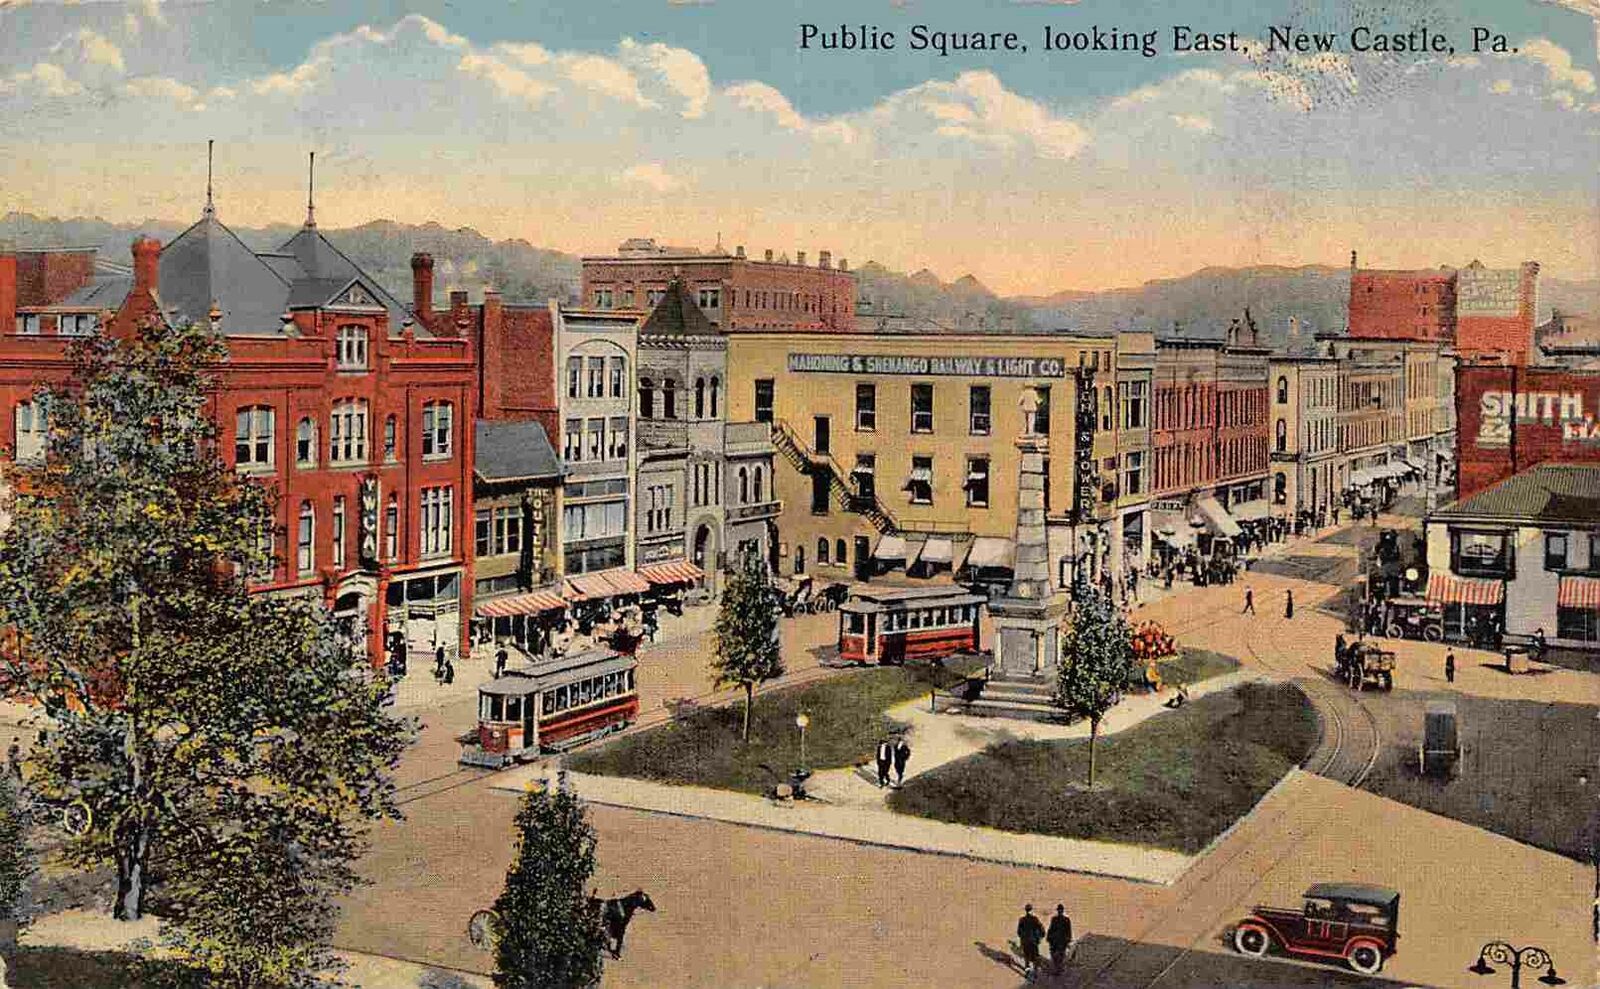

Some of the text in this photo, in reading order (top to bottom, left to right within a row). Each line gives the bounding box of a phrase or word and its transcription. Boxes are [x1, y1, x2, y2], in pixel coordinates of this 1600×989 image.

[790, 354, 849, 372] MAHONING
[851, 356, 863, 372] &
[866, 356, 928, 374] SHENANGO
[930, 357, 980, 375] RAILWAY
[999, 358, 1034, 376] LIGHT
[1040, 358, 1064, 376] CO.
[1080, 432, 1090, 442] &
[1080, 448, 1091, 510] POWER
